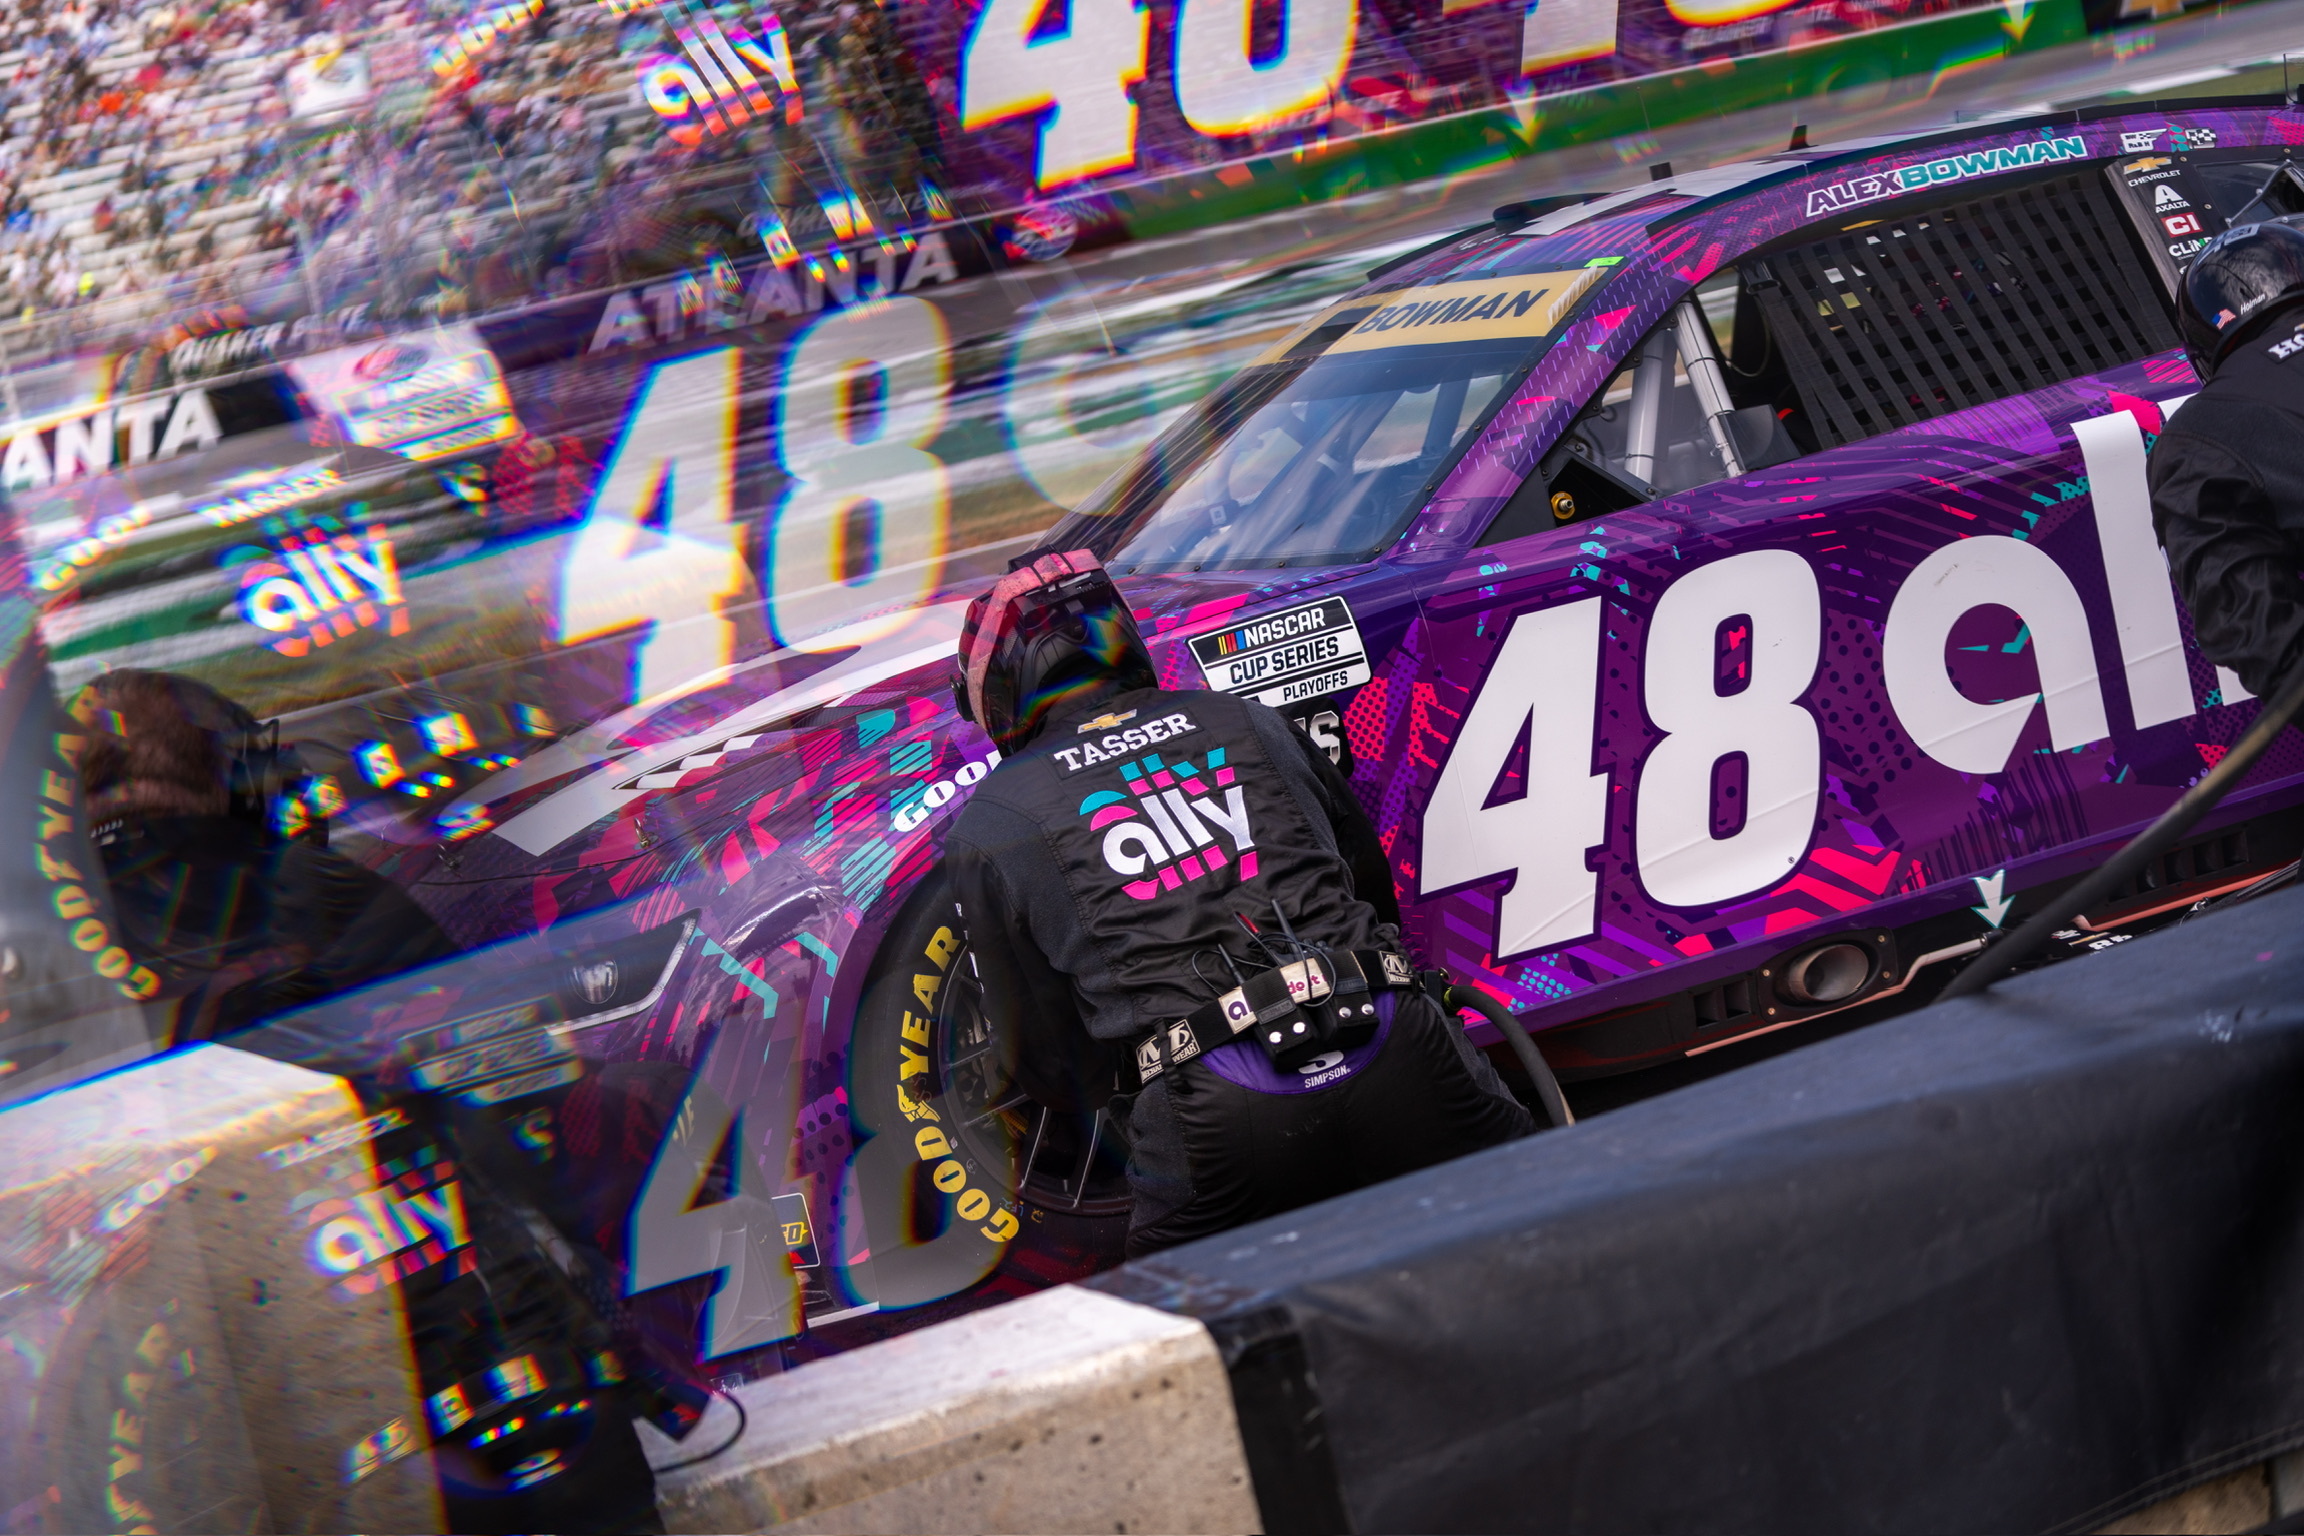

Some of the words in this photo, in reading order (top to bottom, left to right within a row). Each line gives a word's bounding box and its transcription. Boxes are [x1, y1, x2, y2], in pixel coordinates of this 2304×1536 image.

[2128, 169, 2182, 187] CHEVROLET
[2155, 201, 2190, 213] AXALTA
[587, 232, 959, 354] ATLANTA
[1353, 288, 1549, 335] BOWMAN
[555, 296, 952, 705] 48
[240, 538, 406, 633] ally
[1244, 607, 1326, 648] NASCAR
[1229, 656, 1268, 685] CUP
[1272, 636, 1339, 672] SERIES
[1283, 670, 1348, 701] PLAYOFFS
[1054, 713, 1197, 772] TASSER
[1419, 549, 1823, 960] 48
[1102, 785, 1255, 876] ally
[1172, 1042, 1197, 1062] WEAR
[1304, 1066, 1348, 1088] SIMPSON
